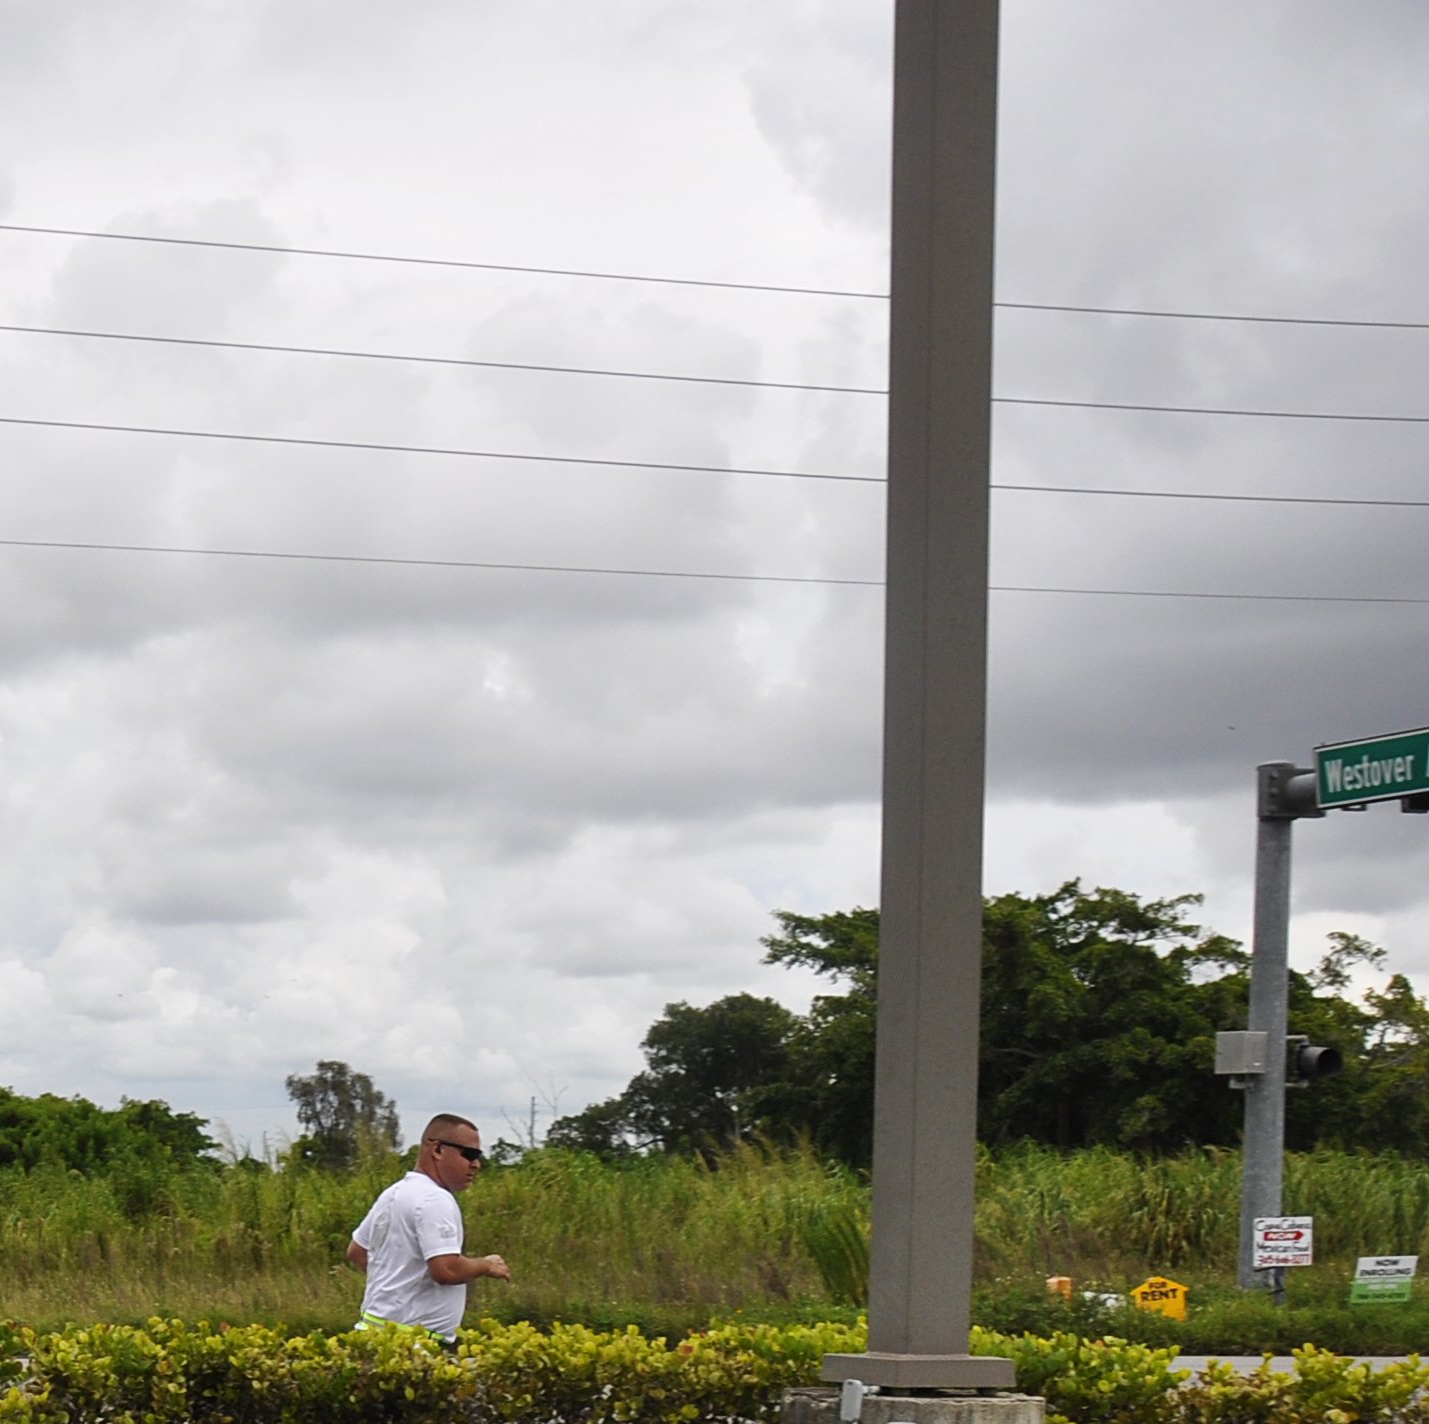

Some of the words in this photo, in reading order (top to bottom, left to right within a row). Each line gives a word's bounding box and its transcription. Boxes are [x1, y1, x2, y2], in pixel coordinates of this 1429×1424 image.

[1325, 755, 1414, 793] Westover
[1359, 1267, 1412, 1276] ENROLLING
[1149, 1281, 1167, 1289] FOR
[1141, 1288, 1178, 1301] RENT
